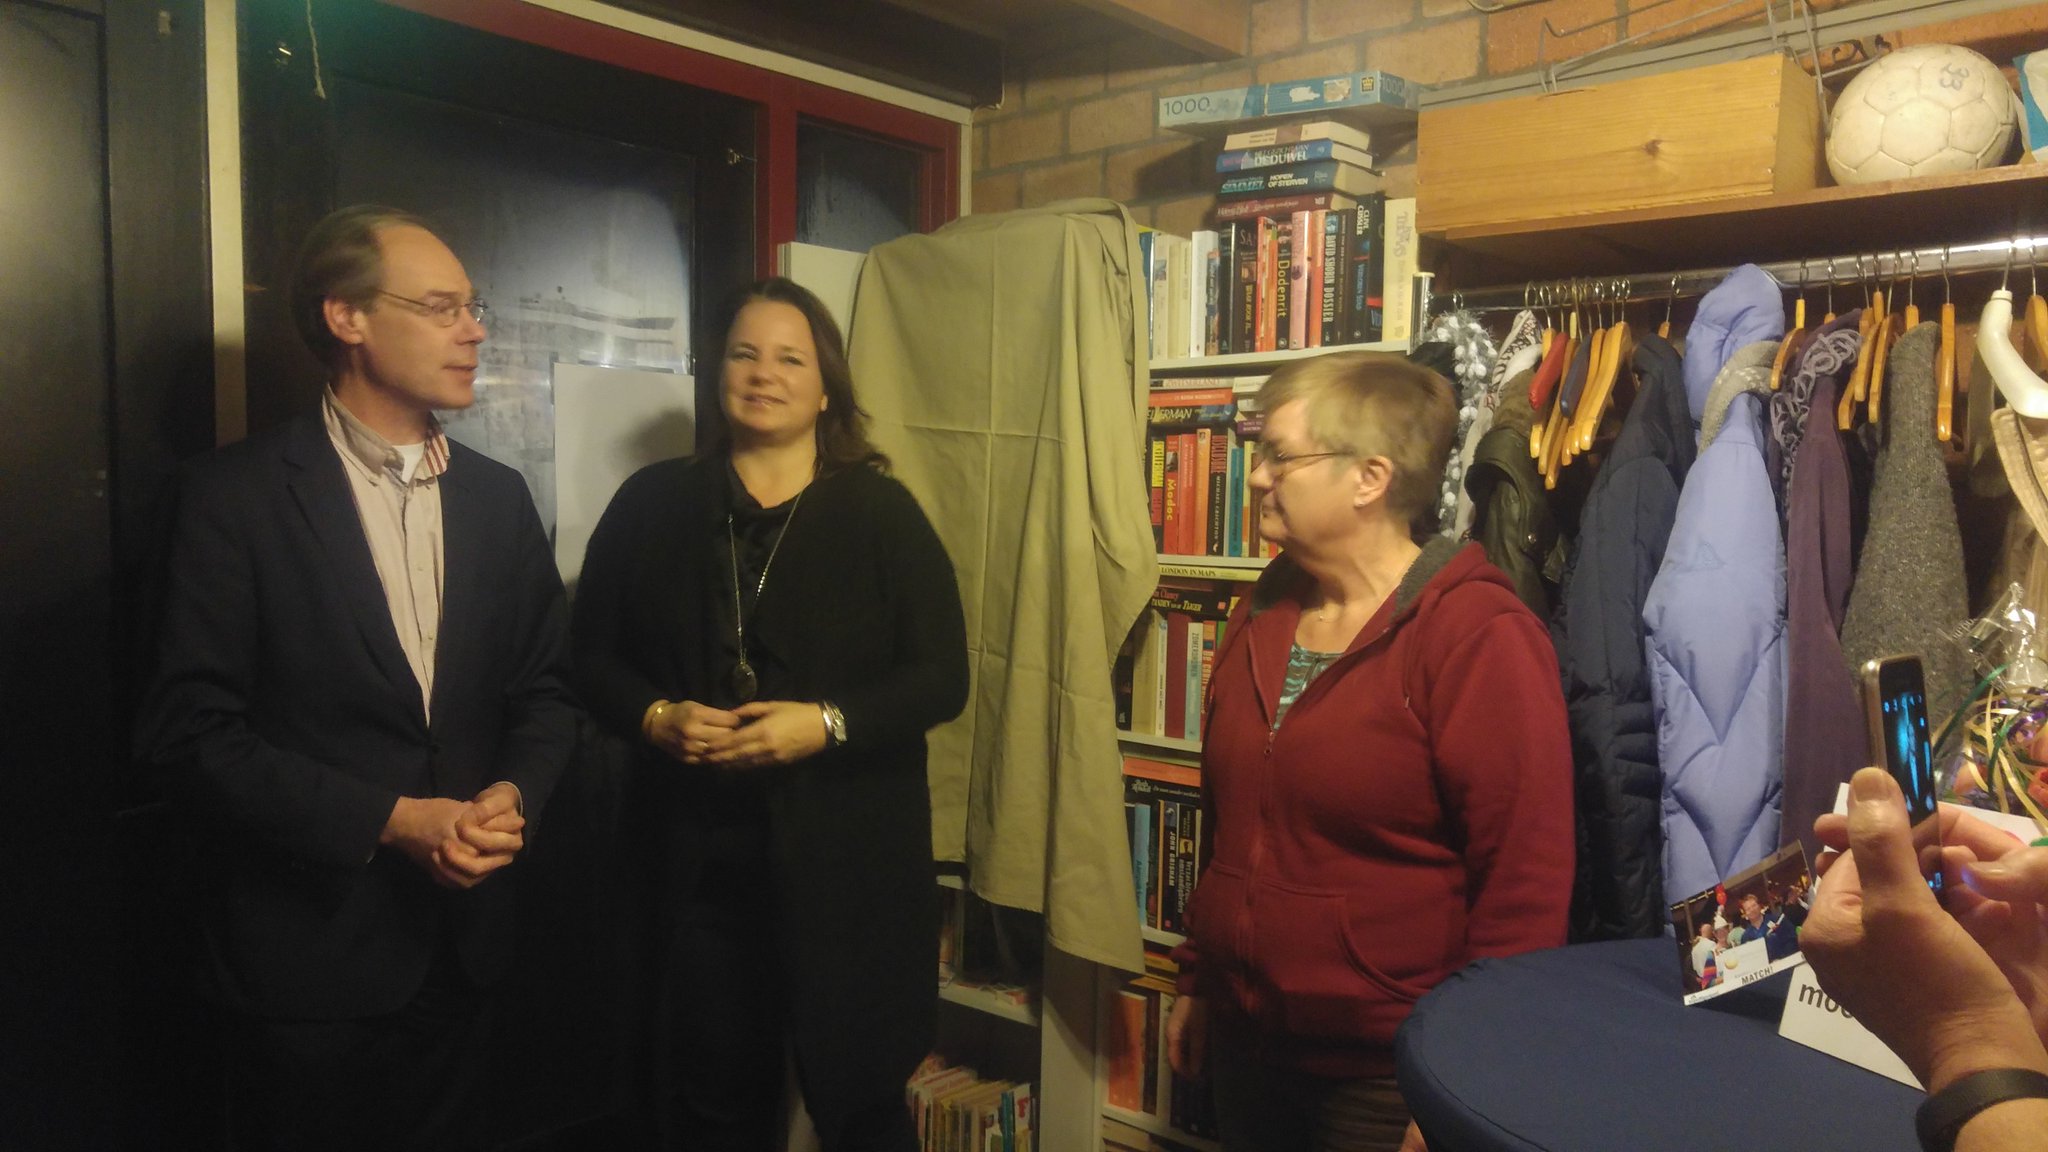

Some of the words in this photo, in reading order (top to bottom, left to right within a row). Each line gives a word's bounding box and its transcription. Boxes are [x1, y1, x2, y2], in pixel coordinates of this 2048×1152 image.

[1164, 96, 1210, 116] 1000
[1270, 150, 1308, 165] DUIVEL
[1356, 205, 1364, 235] CUSSLER
[1362, 209, 1370, 230] CLIVE
[1324, 235, 1337, 256] DAVID
[1278, 260, 1291, 318] Dodenrit
[1323, 287, 1335, 323] DOSSIER
[1160, 566, 1189, 576] LONDON
[1197, 569, 1216, 577] MAPS
[1168, 853, 1176, 886] GRISHAM
[1741, 965, 1774, 985] MATCH!
